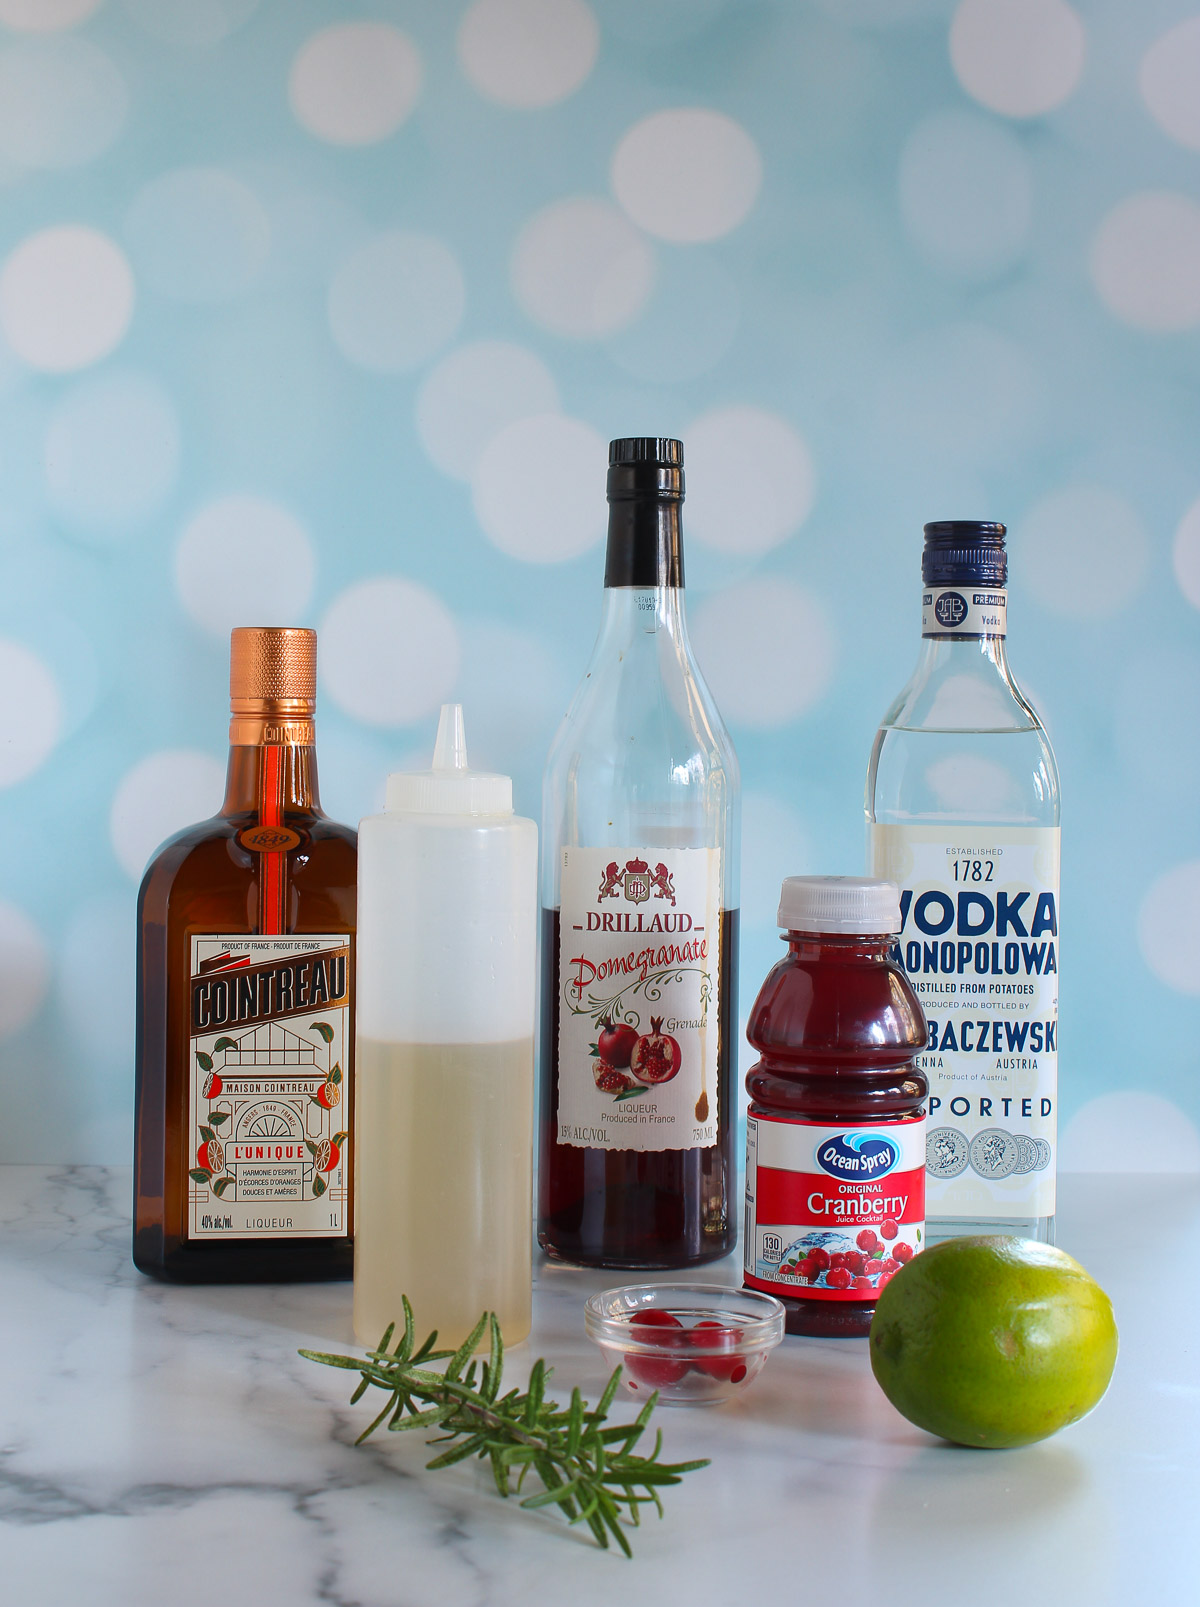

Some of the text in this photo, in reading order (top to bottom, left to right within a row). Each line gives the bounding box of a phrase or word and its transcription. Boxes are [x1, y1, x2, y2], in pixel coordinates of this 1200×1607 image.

[975, 595, 1005, 606] PREMIUM
[981, 615, 1001, 625] Vodka
[945, 848, 1003, 856] ESTABLISHED
[953, 860, 994, 882] 1782
[586, 911, 693, 933] DRILLAUD
[221, 942, 321, 950] PRODUCT OF FRANCE PRODUIT DE FRANCE
[569, 938, 708, 1002] Pomegranate
[194, 955, 347, 1029] COINTREAU
[960, 983, 986, 994] FROM
[989, 983, 1035, 995] POTATOES
[919, 1001, 1030, 1010] RODUCED AND BOTTLED BY
[666, 1015, 707, 1033] Grenade
[915, 1056, 944, 1068] ENNA
[996, 1058, 1038, 1070] AUSTRIA
[938, 1073, 1008, 1082] Product of Austria
[226, 1082, 315, 1093] MAISON COINTREAU
[618, 1103, 658, 1113] LIQUEUR
[928, 1096, 1053, 1117] PORTED
[262, 1104, 277, 1112] 1849
[281, 1109, 296, 1127] FRANCE
[601, 1113, 676, 1123] Produced in France
[561, 1125, 572, 1138] 15%
[692, 1128, 704, 1141] 750
[235, 1145, 304, 1161] L'UNIQUE
[823, 1147, 891, 1173] Ocean Spray
[242, 1168, 298, 1177] HARMONIE D'ESPRIT
[239, 1177, 302, 1186] D'ÉCORCES D'ORANGES
[242, 1187, 298, 1196] DOUCES ET AMÈRES
[838, 1184, 883, 1193] ORIGINAL
[807, 1192, 909, 1220] Cranberry
[201, 1214, 213, 1229] 40%
[246, 1217, 293, 1228] LIQUEUR
[835, 1215, 884, 1223] Juice Cocktail
[765, 1236, 779, 1250] 130
[762, 1270, 809, 1285] FROM CONCENTRATE
